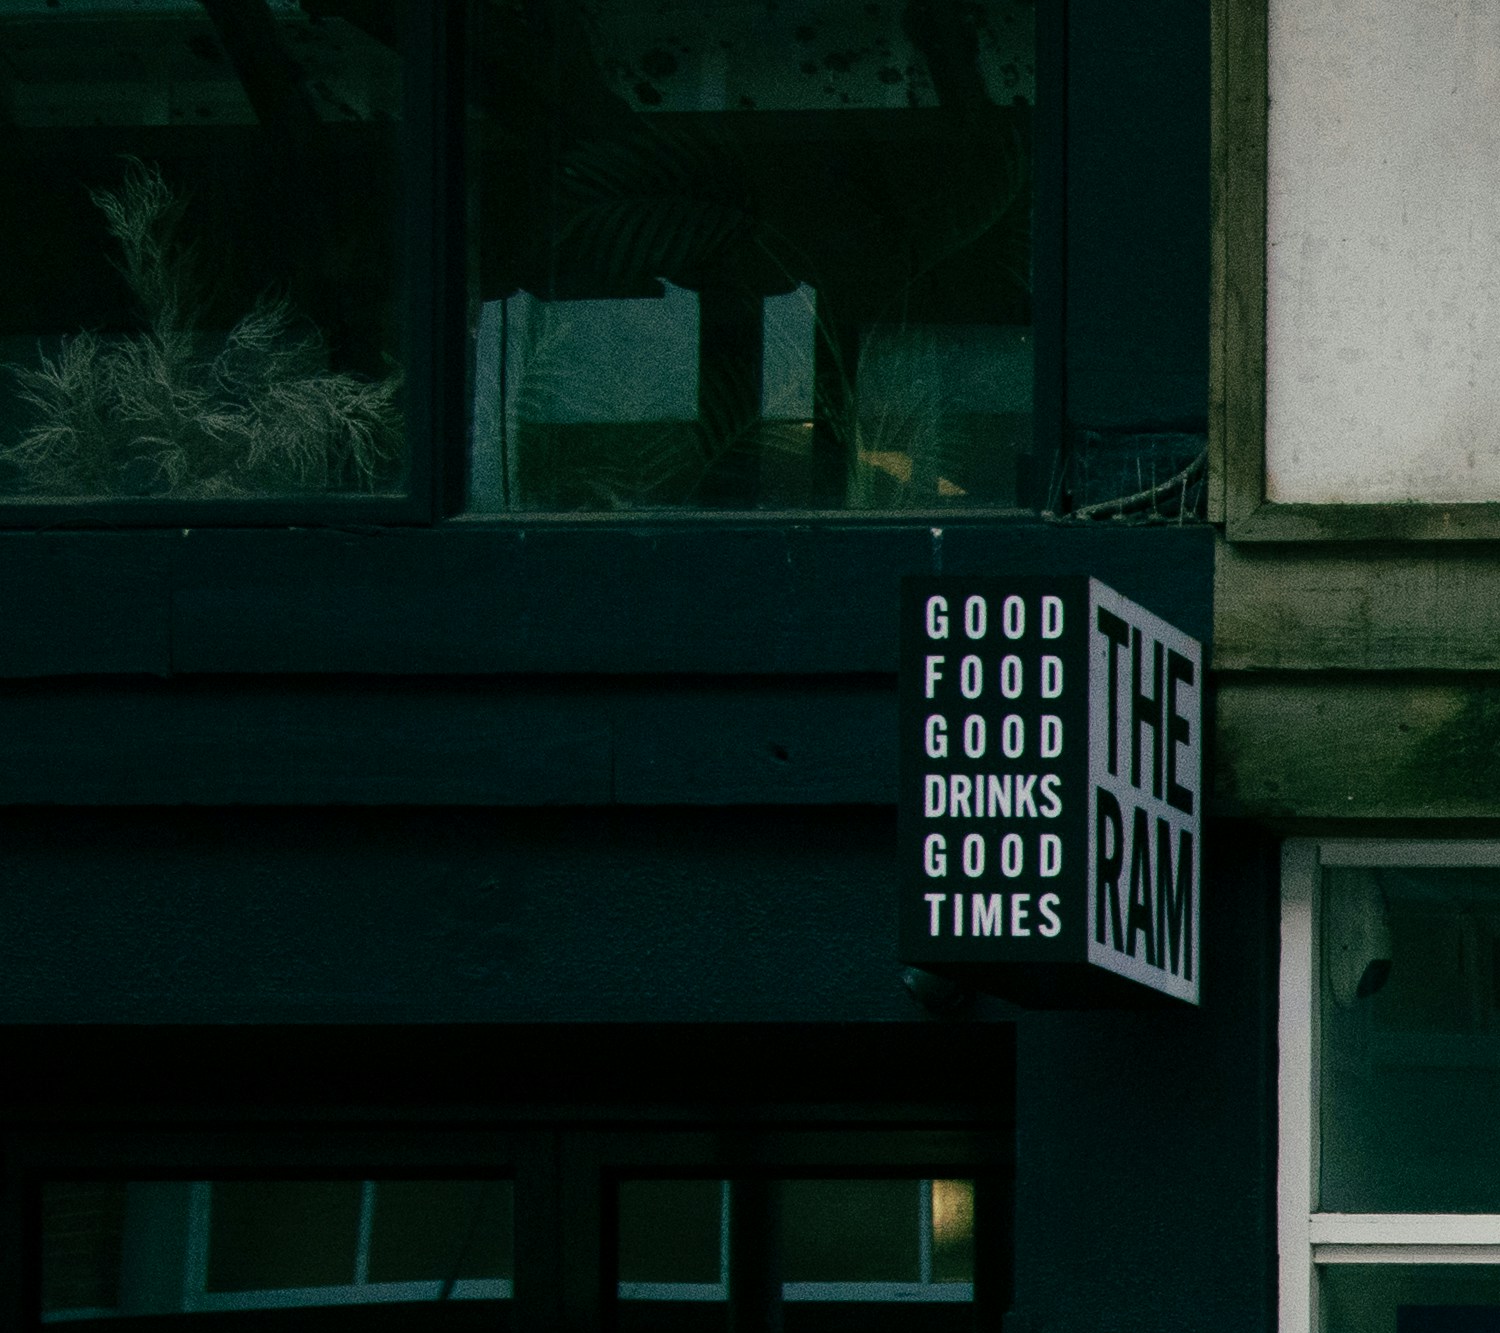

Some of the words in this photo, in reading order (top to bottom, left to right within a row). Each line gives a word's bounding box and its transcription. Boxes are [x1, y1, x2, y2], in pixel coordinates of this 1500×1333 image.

[924, 595, 1063, 640] GOOD
[924, 654, 1063, 699] FOOD
[1097, 604, 1195, 816] THE
[924, 714, 1063, 759] GOOD
[924, 774, 1063, 818] DRINKS
[924, 833, 1063, 878] GOOD
[1096, 785, 1194, 983] RAM
[924, 893, 1063, 937] TIMES
